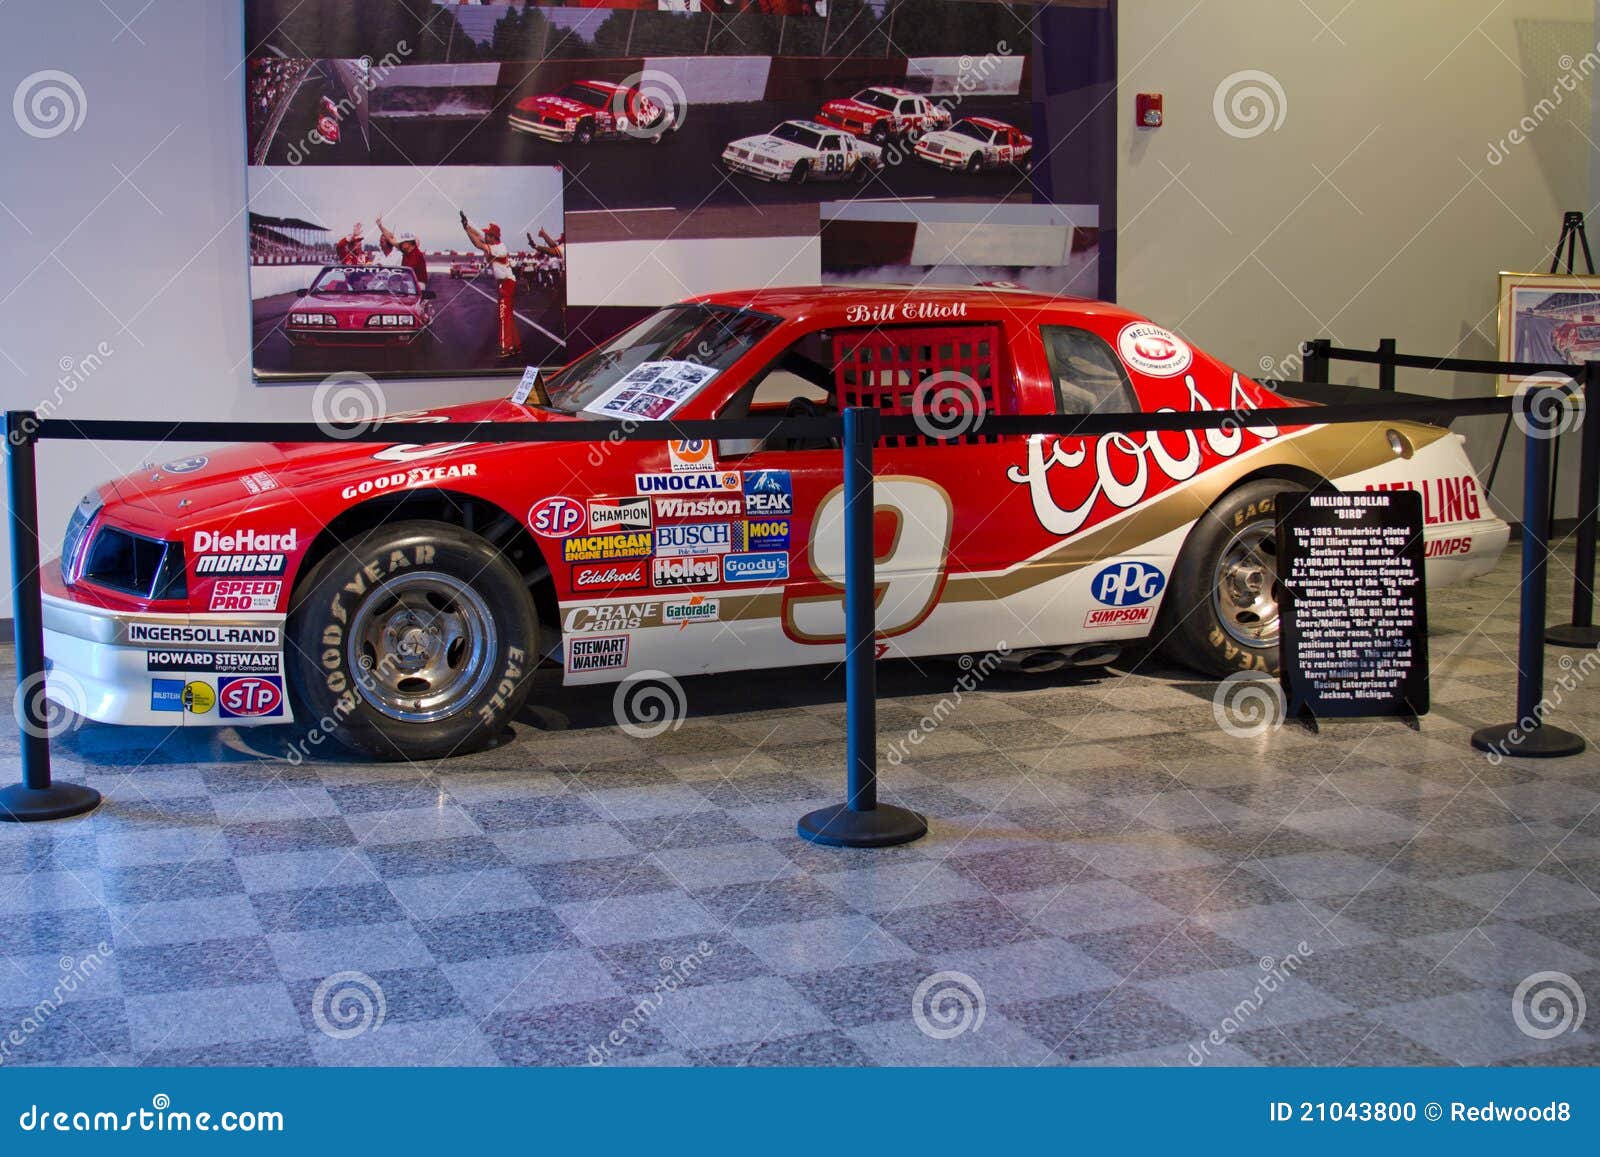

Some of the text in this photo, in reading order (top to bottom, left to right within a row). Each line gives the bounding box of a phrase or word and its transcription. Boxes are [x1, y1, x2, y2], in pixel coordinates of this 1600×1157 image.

[826, 153, 843, 174] 88
[331, 266, 404, 275] PONTIAC
[846, 302, 968, 322] Bill Elliott
[1129, 328, 1171, 340] MELLING
[341, 463, 478, 500] GOODYEAR
[638, 475, 738, 491] UNOCAL 76
[656, 497, 742, 518] Winston
[745, 493, 791, 510] PEAK
[1310, 496, 1390, 506] MILLION DOLLAR
[1365, 475, 1481, 525] LING
[535, 501, 579, 531] STP
[592, 508, 648, 522] CHAMPION
[1234, 498, 1275, 526] EAG
[1334, 508, 1366, 519] "BIRD"
[657, 524, 729, 547] BUSCH
[750, 522, 789, 537] MOOG
[1293, 527, 1410, 537] This 1985 Thunderbird piloted
[193, 527, 297, 552] DieHard
[565, 533, 652, 553] MICHIGAN
[1299, 538, 1308, 547] by
[1385, 537, 1405, 545] 1985
[1424, 537, 1472, 557] UMPS
[565, 547, 652, 561] ENGINE BEARINGS
[1310, 548, 1346, 556] Southern
[1381, 547, 1394, 555] the
[196, 554, 285, 573] MOROSO
[726, 557, 787, 575] Goody's
[781, 474, 954, 645] 9
[1293, 558, 1339, 567] $1,000,000
[1341, 558, 1364, 566] bonus
[1402, 558, 1411, 566] by
[577, 568, 641, 585] Edelbrock
[655, 558, 718, 581] Holley
[1292, 568, 1413, 577] R.J. Reynolds Tobacco Company
[214, 581, 277, 596] SPEED
[1099, 563, 1159, 605] PPG
[1284, 579, 1297, 587] for
[1299, 579, 1329, 588] winning
[1331, 578, 1353, 586] three
[1355, 578, 1363, 586] of
[1365, 578, 1378, 586] the
[1398, 578, 1419, 586] Four"
[1306, 589, 1338, 597] Winston
[1340, 589, 1354, 597] Cup
[1387, 588, 1401, 596] The
[211, 596, 253, 610] PRO
[666, 603, 716, 617] Gatorade
[1294, 599, 1325, 608] Daytona
[1347, 598, 1379, 606] Winston
[1381, 598, 1396, 606] 500
[1398, 598, 1413, 606] and
[563, 601, 660, 633] CRANE
[1089, 608, 1149, 623] SIMPSON
[1297, 609, 1309, 617] the
[1311, 609, 1347, 617] Southern
[1349, 609, 1367, 617] 500.
[1401, 608, 1414, 616] the
[1296, 619, 1350, 628] Coors/Melling
[1352, 619, 1376, 627] "Bird"
[131, 626, 276, 643] INGERSOLL-RAND
[1302, 630, 1322, 639] eight
[1324, 629, 1345, 637] other
[1347, 630, 1371, 638] races,
[1386, 628, 1403, 637] pole
[573, 639, 625, 655] STEWART
[1298, 640, 1333, 650] positions
[1336, 640, 1350, 648] and
[149, 652, 278, 666] HOWARD STEWART
[573, 653, 623, 669] WARNER
[1337, 650, 1359, 658] 1985.
[1314, 660, 1358, 668] restoration
[1377, 660, 1391, 669] gift
[1304, 671, 1327, 679] Harry
[1328, 670, 1358, 679] Melling
[1377, 670, 1406, 679] Melling
[478, 646, 525, 727] EAGLE
[1342, 680, 1387, 689] Enterprises
[228, 681, 273, 710] STP
[1319, 690, 1393, 700] Jackson, Michigan.
